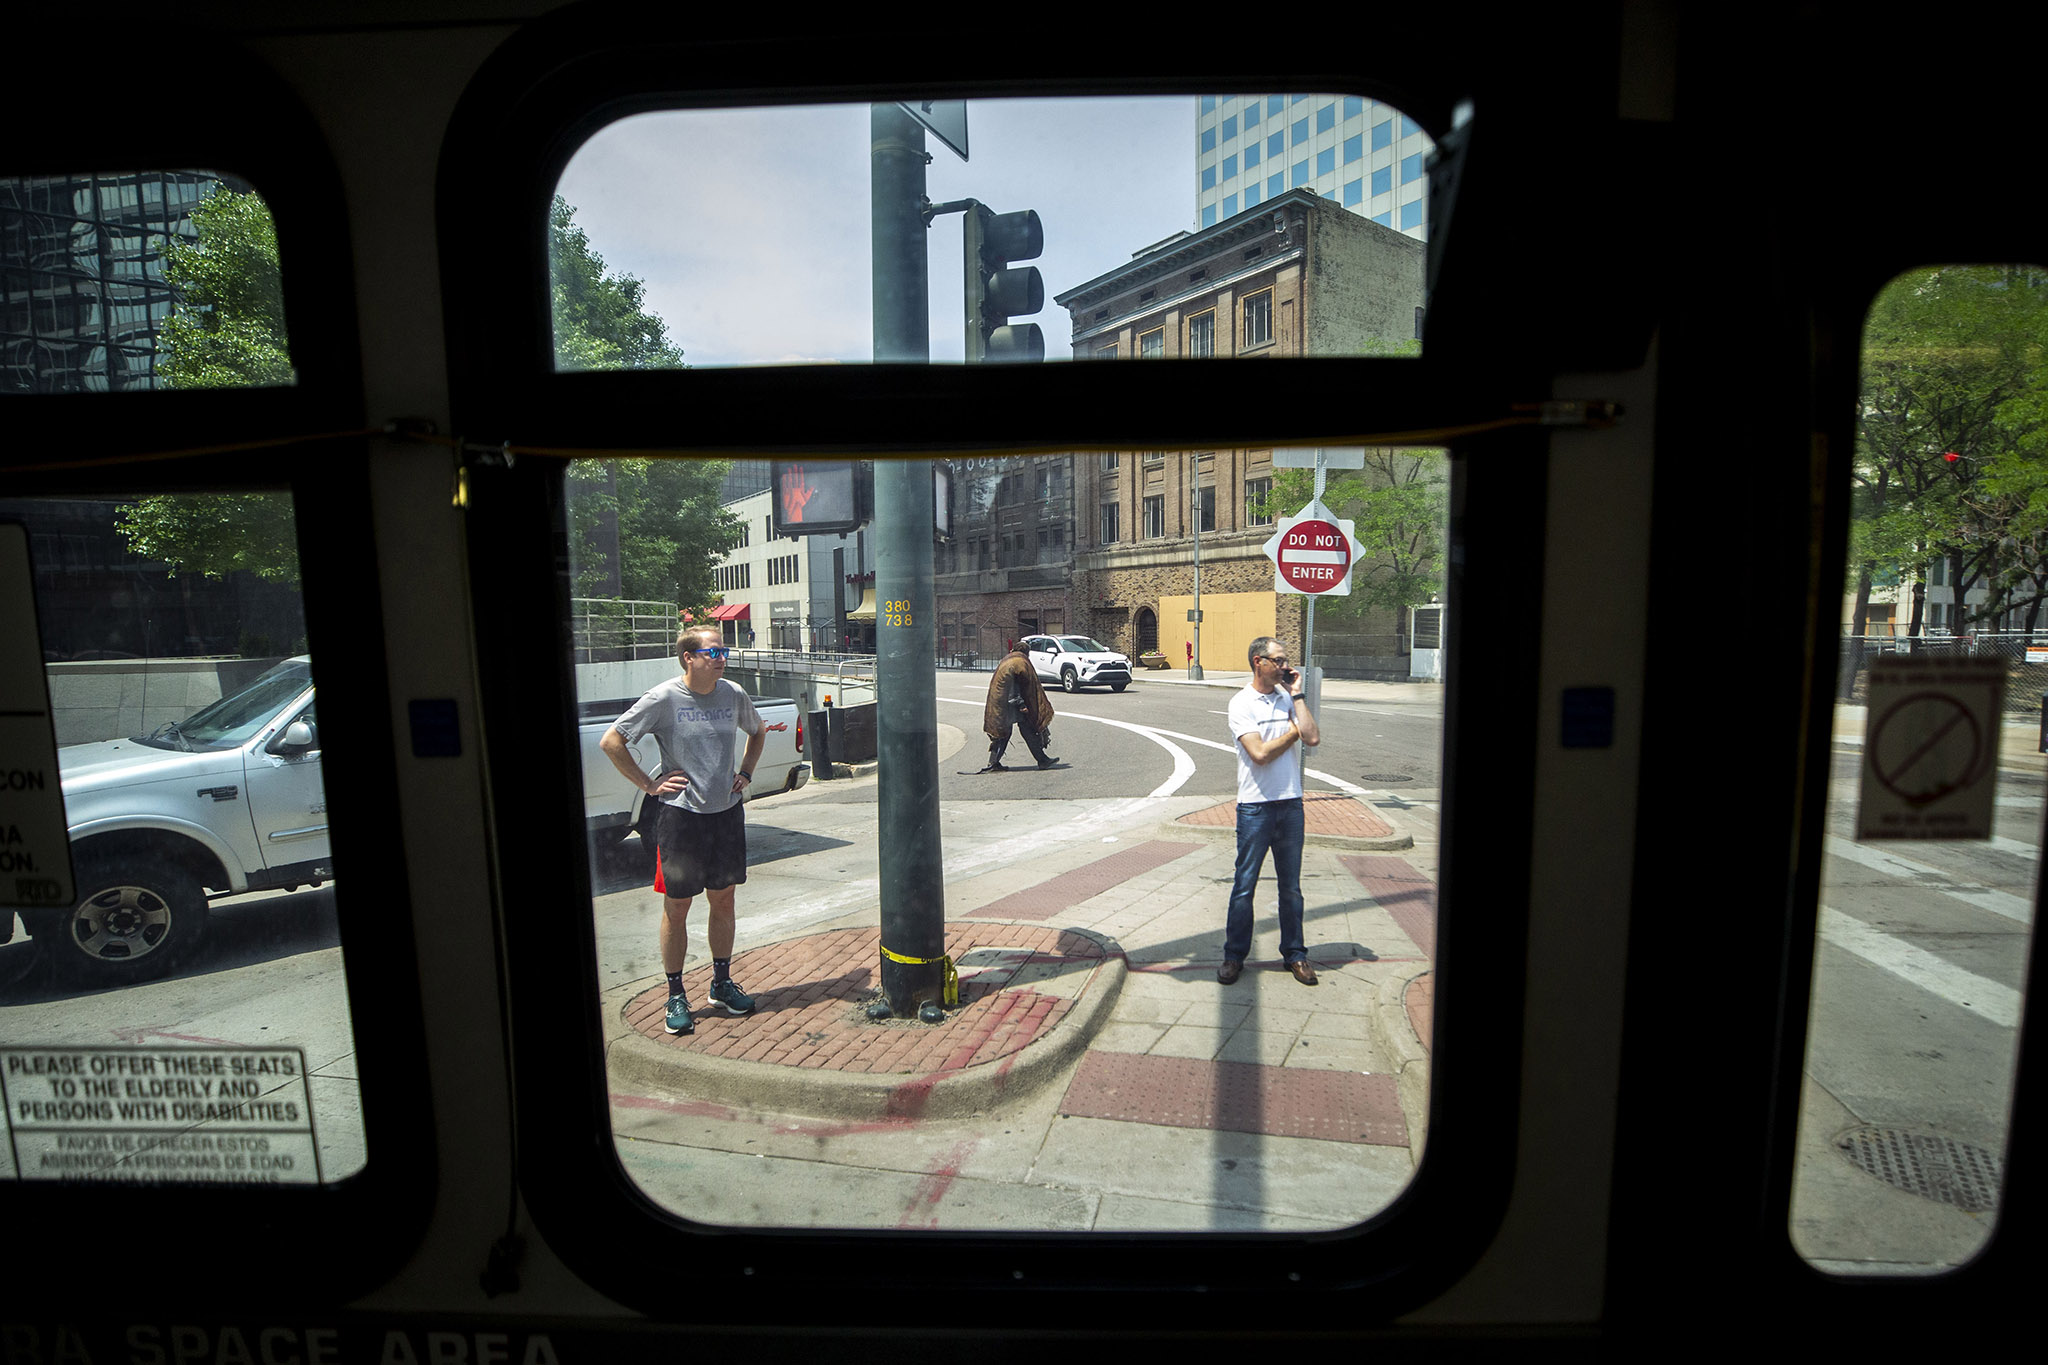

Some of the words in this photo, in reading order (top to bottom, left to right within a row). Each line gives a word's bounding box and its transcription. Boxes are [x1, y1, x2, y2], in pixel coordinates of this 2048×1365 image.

[1289, 534, 1307, 546] DO
[1315, 535, 1341, 547] NOT
[1292, 567, 1334, 580] ENTER
[885, 600, 911, 613] 380
[885, 614, 913, 627] 738
[9, 1056, 85, 1075] PLEASE
[91, 1056, 156, 1075] OFFER
[163, 1056, 226, 1075] THESE
[232, 1056, 295, 1075] SEATS
[50, 1079, 76, 1098] TO
[84, 1079, 120, 1097] THE
[126, 1078, 212, 1097] ELDERLY
[218, 1078, 260, 1097] AND
[19, 1102, 113, 1121] PERSONS
[118, 1102, 167, 1120] WITH
[172, 1102, 299, 1121] DISABILITIES
[56, 1136, 107, 1152] FAVOR
[112, 1136, 133, 1152] DE
[137, 1136, 212, 1152] OFRECER
[217, 1136, 270, 1152] ESTOS
[40, 1154, 118, 1169] ASIENTOS
[133, 1154, 221, 1170] PERSONAS
[224, 1154, 246, 1169] DE
[250, 1154, 294, 1170] EDAD
[126, 1324, 340, 1365] SPACE
[380, 1329, 559, 1365] AREA
